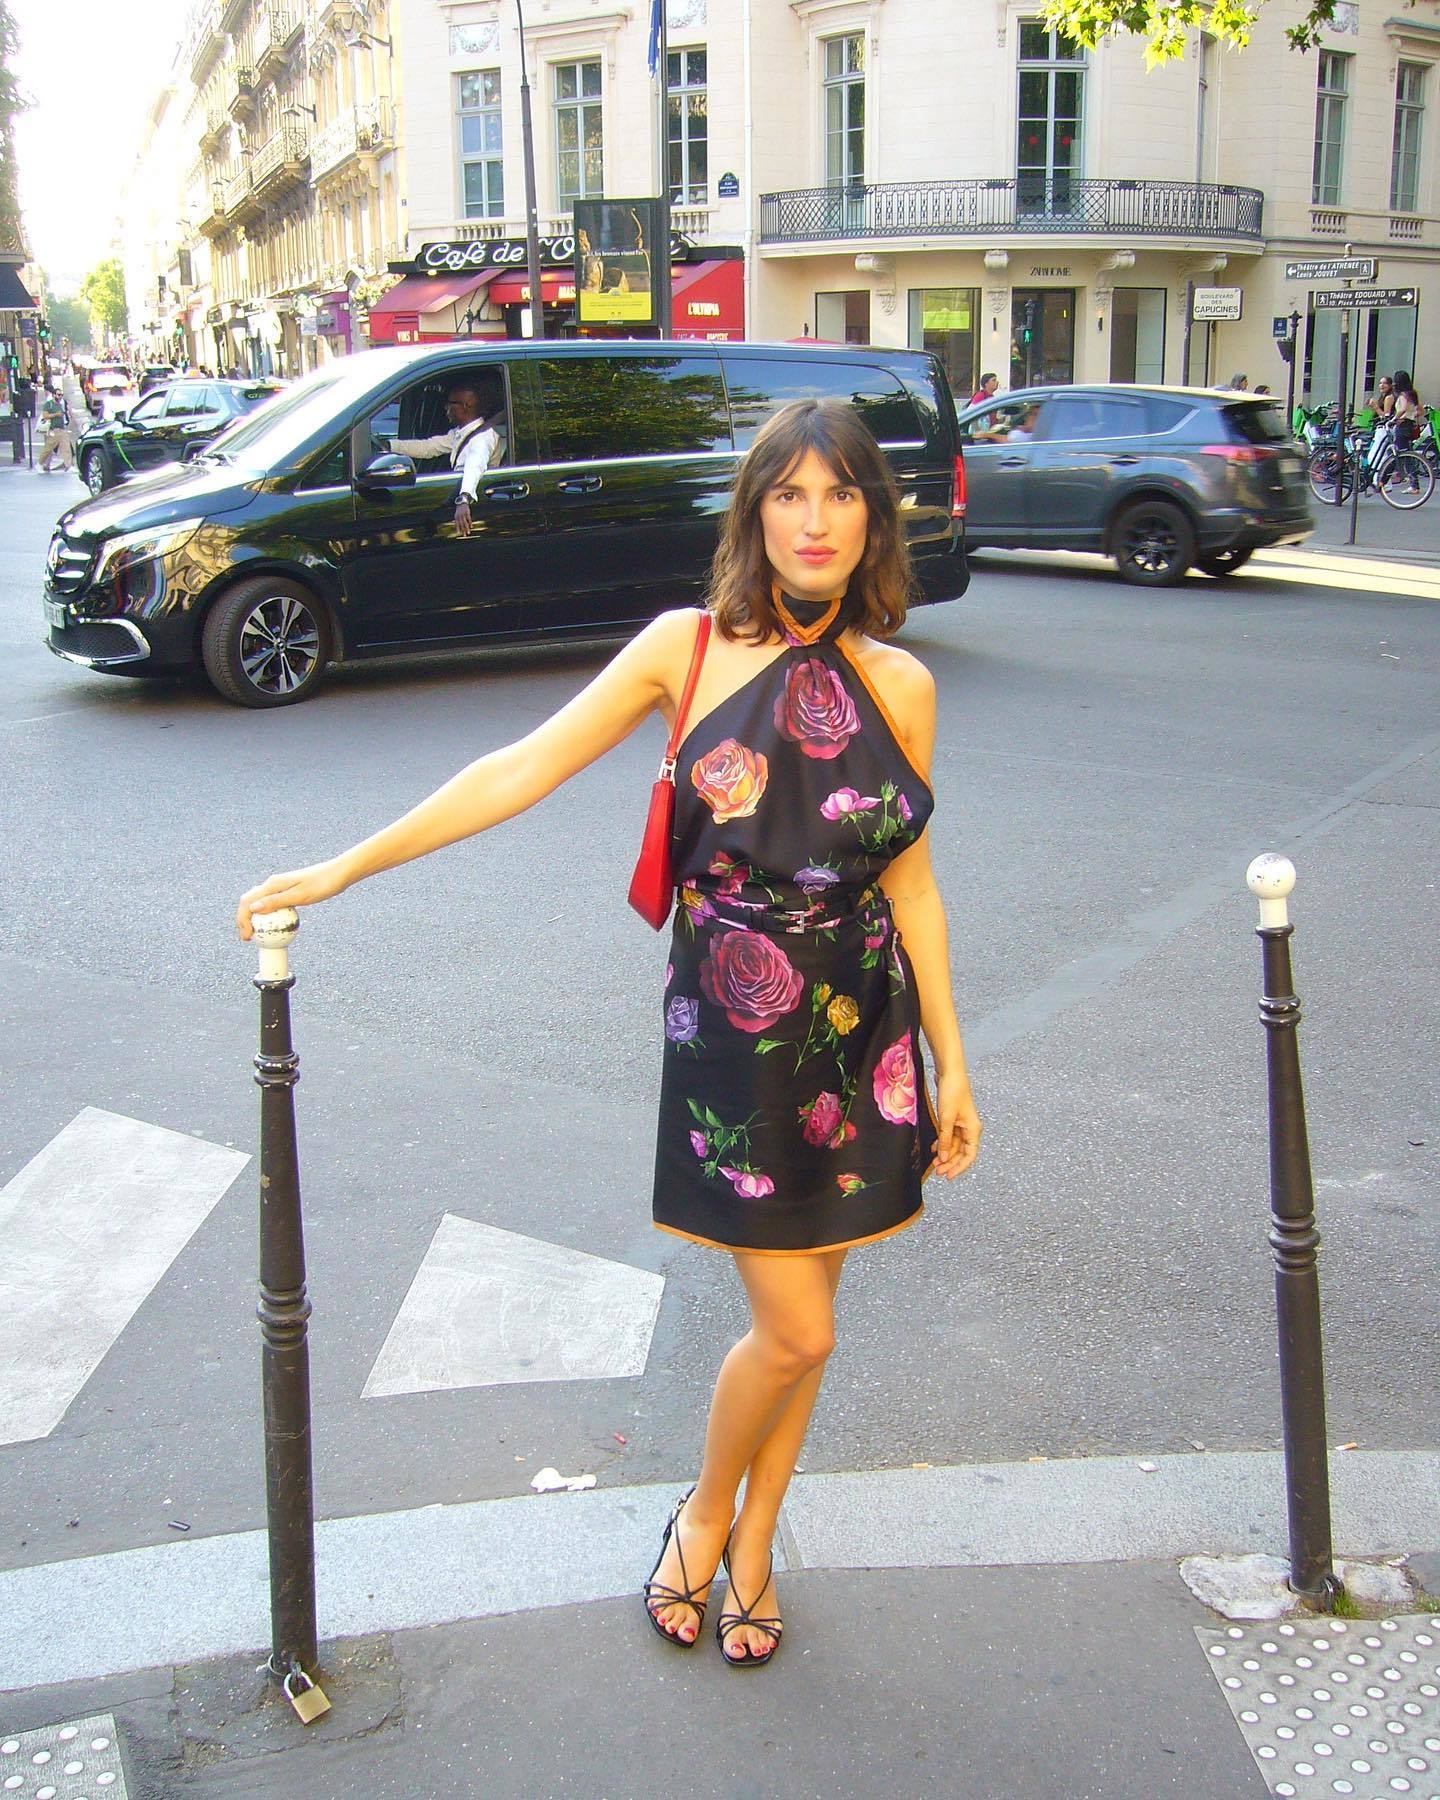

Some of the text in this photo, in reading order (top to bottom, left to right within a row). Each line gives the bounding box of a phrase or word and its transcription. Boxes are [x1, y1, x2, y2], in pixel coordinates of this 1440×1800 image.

[425, 242, 486, 270] Café
[492, 242, 524, 263] de
[1329, 292, 1353, 300] Théâtre
[1354, 290, 1386, 299] EDOUARD
[1194, 305, 1239, 314] CAPUCINES
